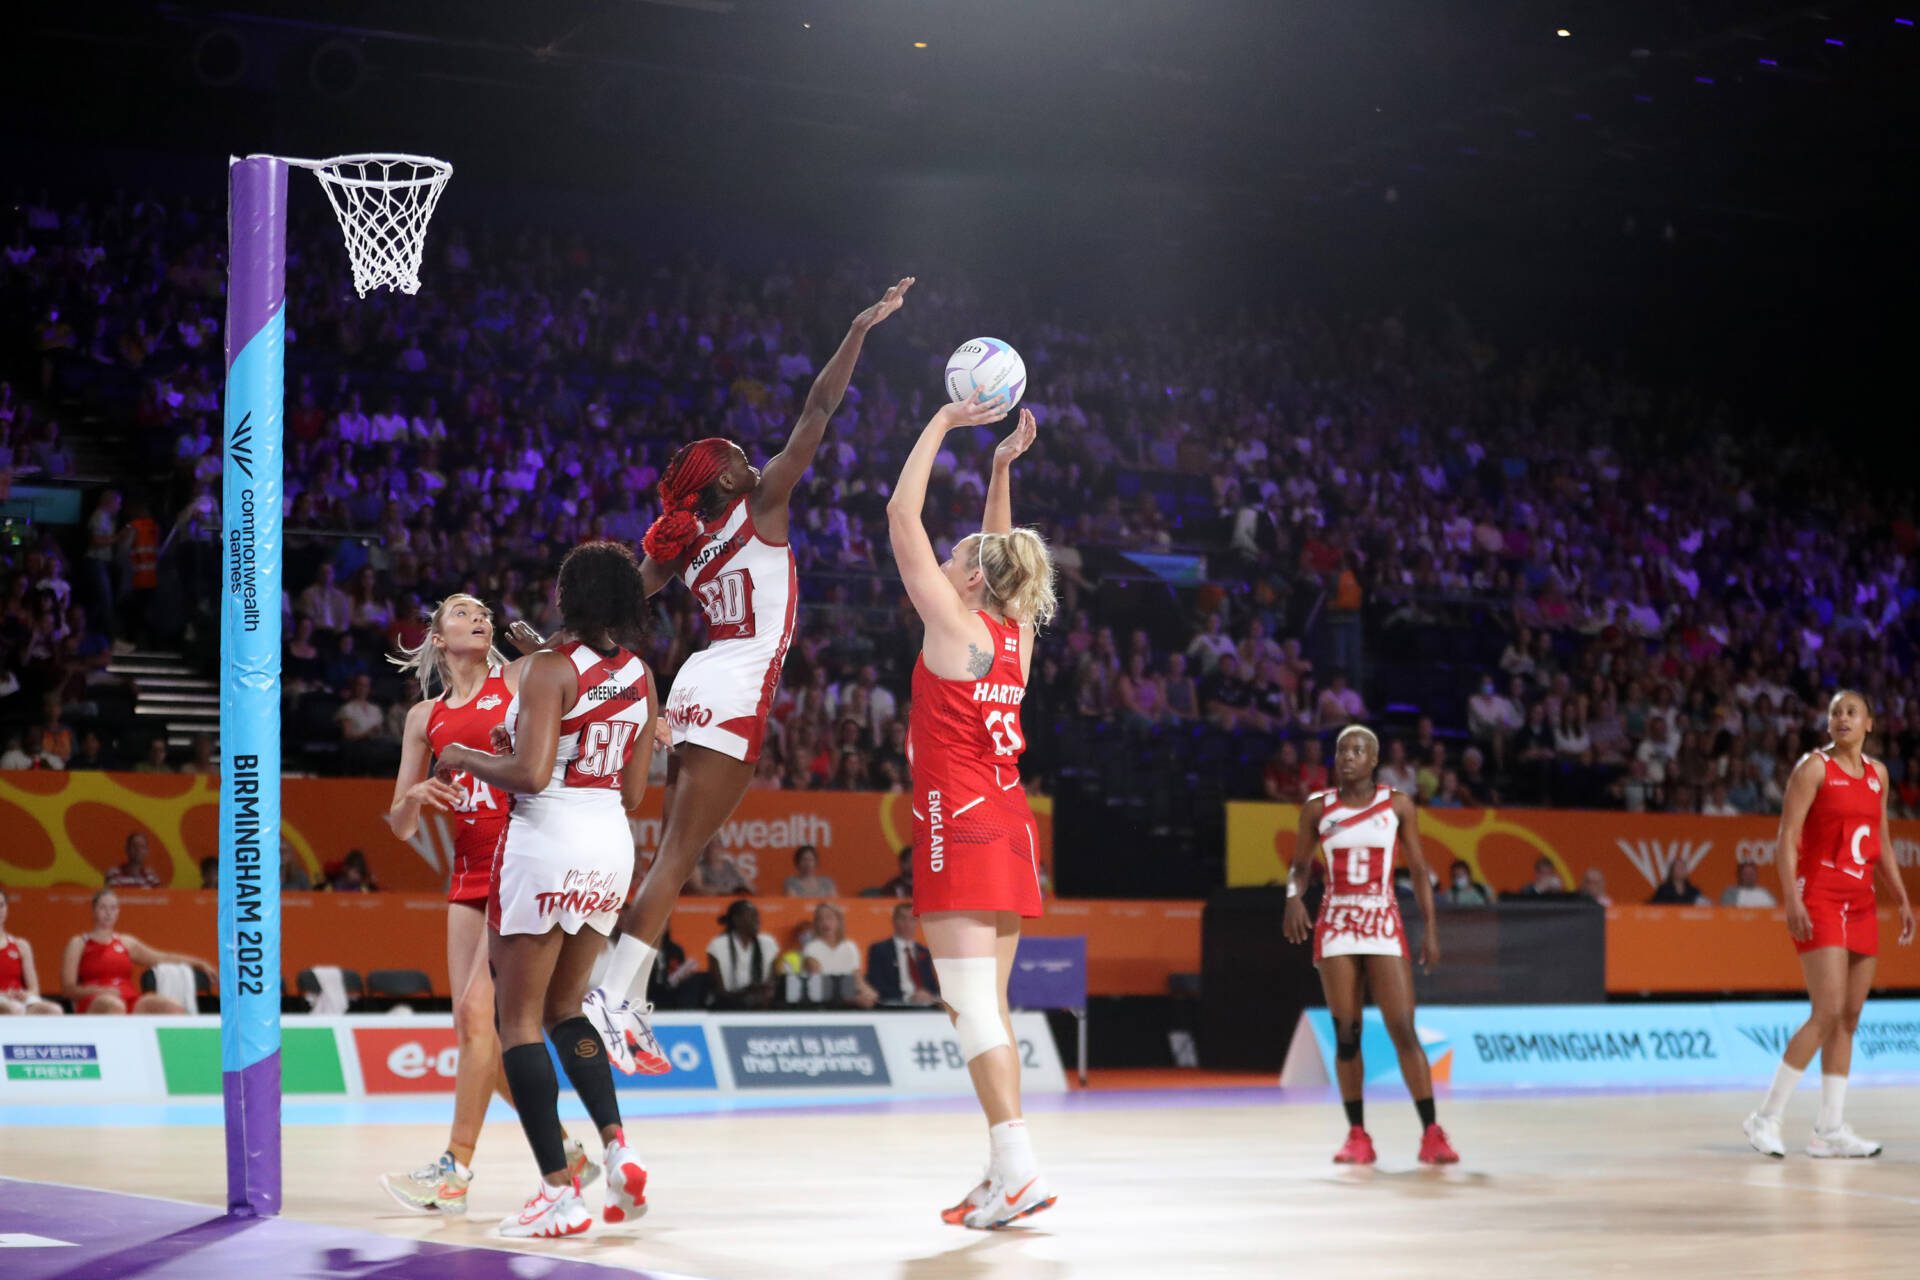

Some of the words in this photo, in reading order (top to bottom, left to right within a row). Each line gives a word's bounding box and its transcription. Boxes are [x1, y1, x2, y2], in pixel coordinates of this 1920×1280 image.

[230, 530, 242, 594] games
[241, 489, 260, 632] commonwealth
[699, 571, 746, 625] GD
[576, 721, 634, 777] GH
[985, 710, 1022, 756] GS
[233, 754, 262, 923] BIRMINGHAM
[928, 790, 945, 873] ENGLAND
[1851, 824, 1871, 866] C
[237, 931, 263, 996] 2022
[12, 1046, 89, 1060] SEVERN
[742, 1053, 777, 1074] the
[778, 1053, 875, 1077] beginning
[747, 1036, 799, 1055] sport
[801, 1036, 821, 1054] is
[822, 1036, 859, 1057] just
[1473, 1032, 1649, 1063] BIRMINGHAM
[1649, 1030, 1717, 1060] 2022
[23, 1066, 83, 1079] TRENT
